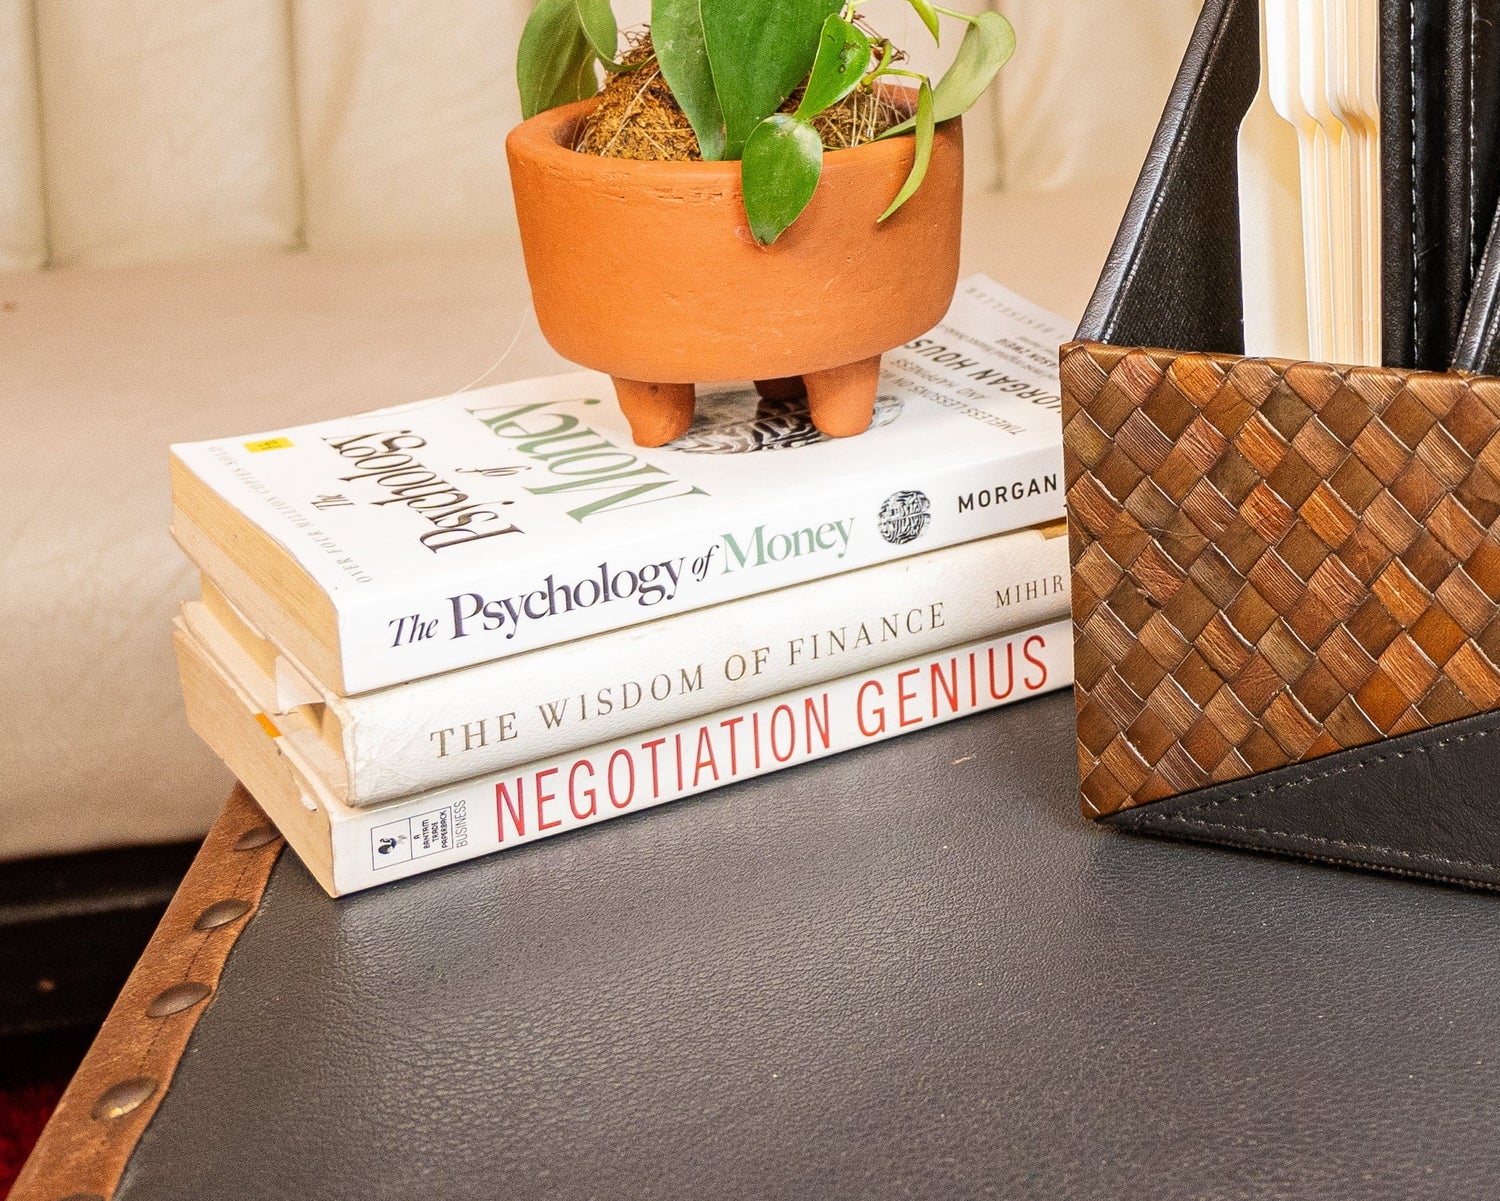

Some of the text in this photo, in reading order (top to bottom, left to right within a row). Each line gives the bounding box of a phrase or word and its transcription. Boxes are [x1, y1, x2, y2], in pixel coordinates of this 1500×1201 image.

[904, 338, 979, 371] HOUS
[960, 407, 1027, 436] TIMELESS
[454, 465, 534, 478] of
[464, 398, 712, 524] Money
[310, 493, 356, 511] The
[321, 428, 526, 555] Psychology
[267, 496, 313, 529] MILLION
[307, 530, 343, 554] FOUR
[336, 557, 373, 584] OVER
[388, 473, 1058, 648] The Psychology of Money MORGAN
[429, 574, 1064, 759] THE WISDOM OF FINANCE MIHIR
[494, 634, 1049, 843] NEGOTIATION GENIUS
[421, 818, 431, 850] BANTAM
[431, 821, 439, 843] TRADE
[439, 809, 449, 849] PAPERBACK
[453, 799, 469, 849] BUSINESS
